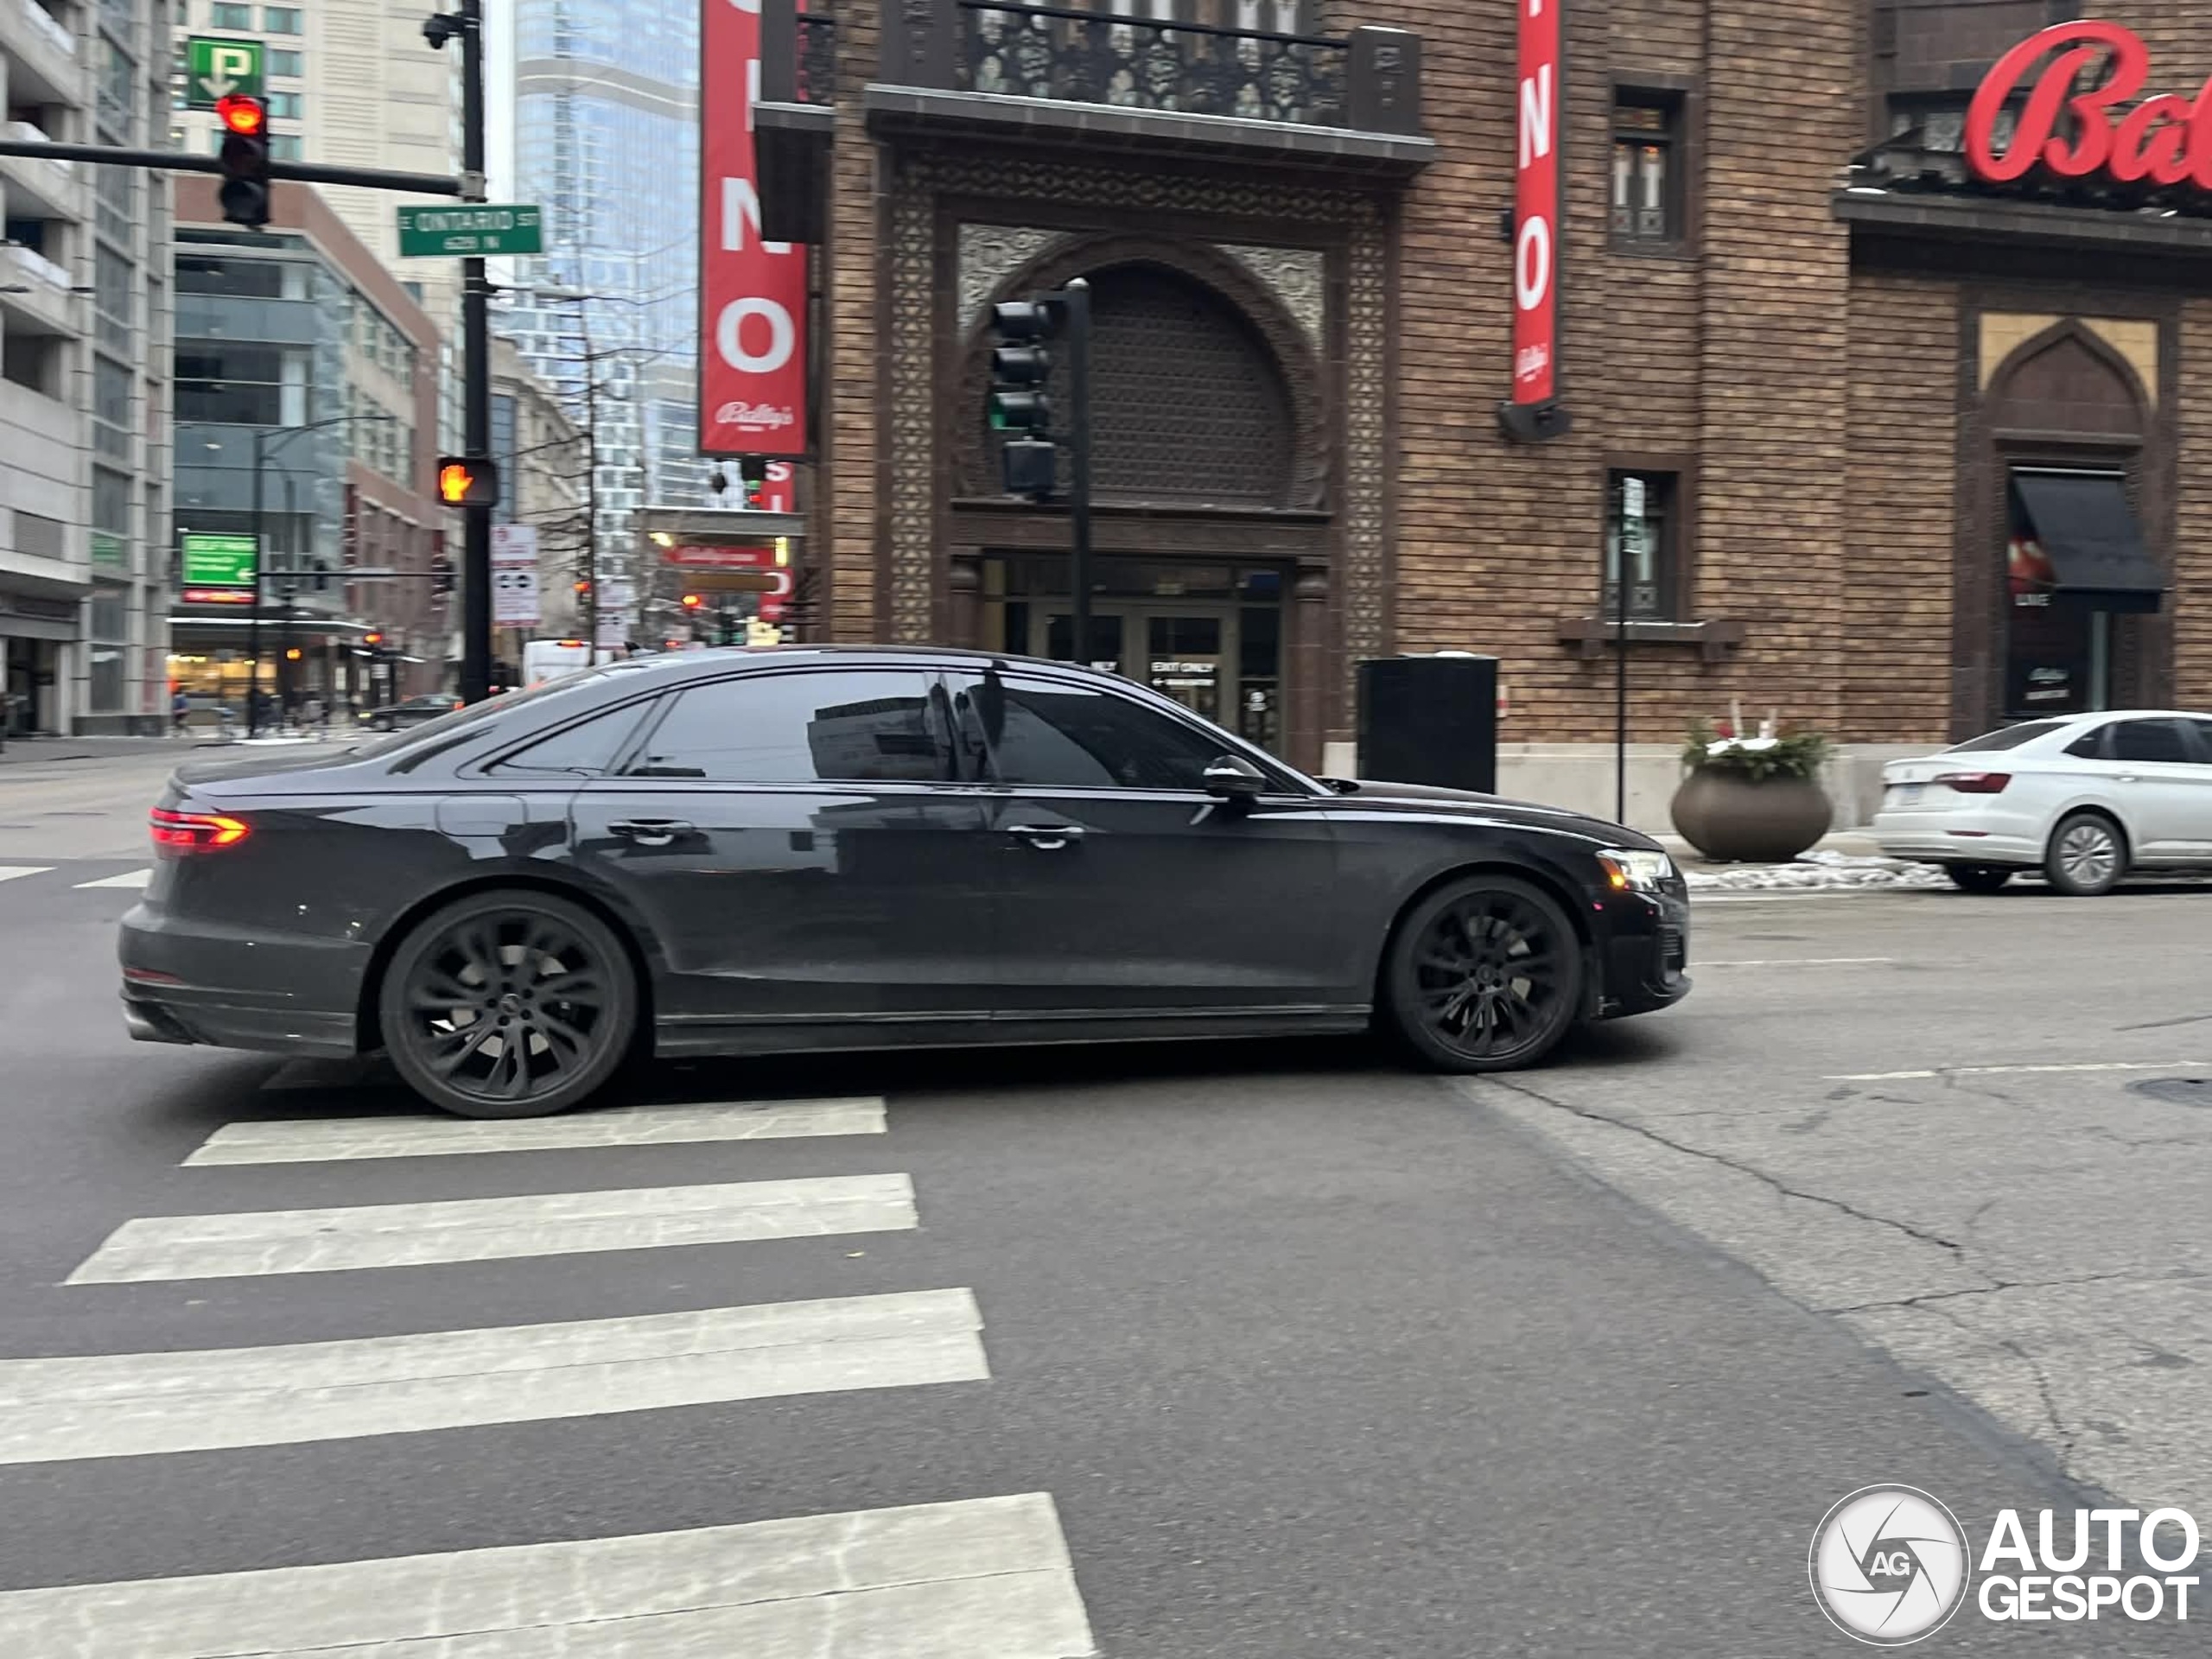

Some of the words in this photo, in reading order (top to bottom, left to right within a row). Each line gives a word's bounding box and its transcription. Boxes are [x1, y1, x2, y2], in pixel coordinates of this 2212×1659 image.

[210, 48, 252, 80] P
[1516, 0, 1551, 311] NO
[716, 0, 796, 373] INO
[398, 216, 413, 230] E
[414, 211, 514, 232] ONTARIO
[517, 213, 538, 226] ST
[715, 402, 793, 429] Bally's
[1151, 662, 1180, 672] EXIT
[1180, 662, 1217, 672] ONLY
